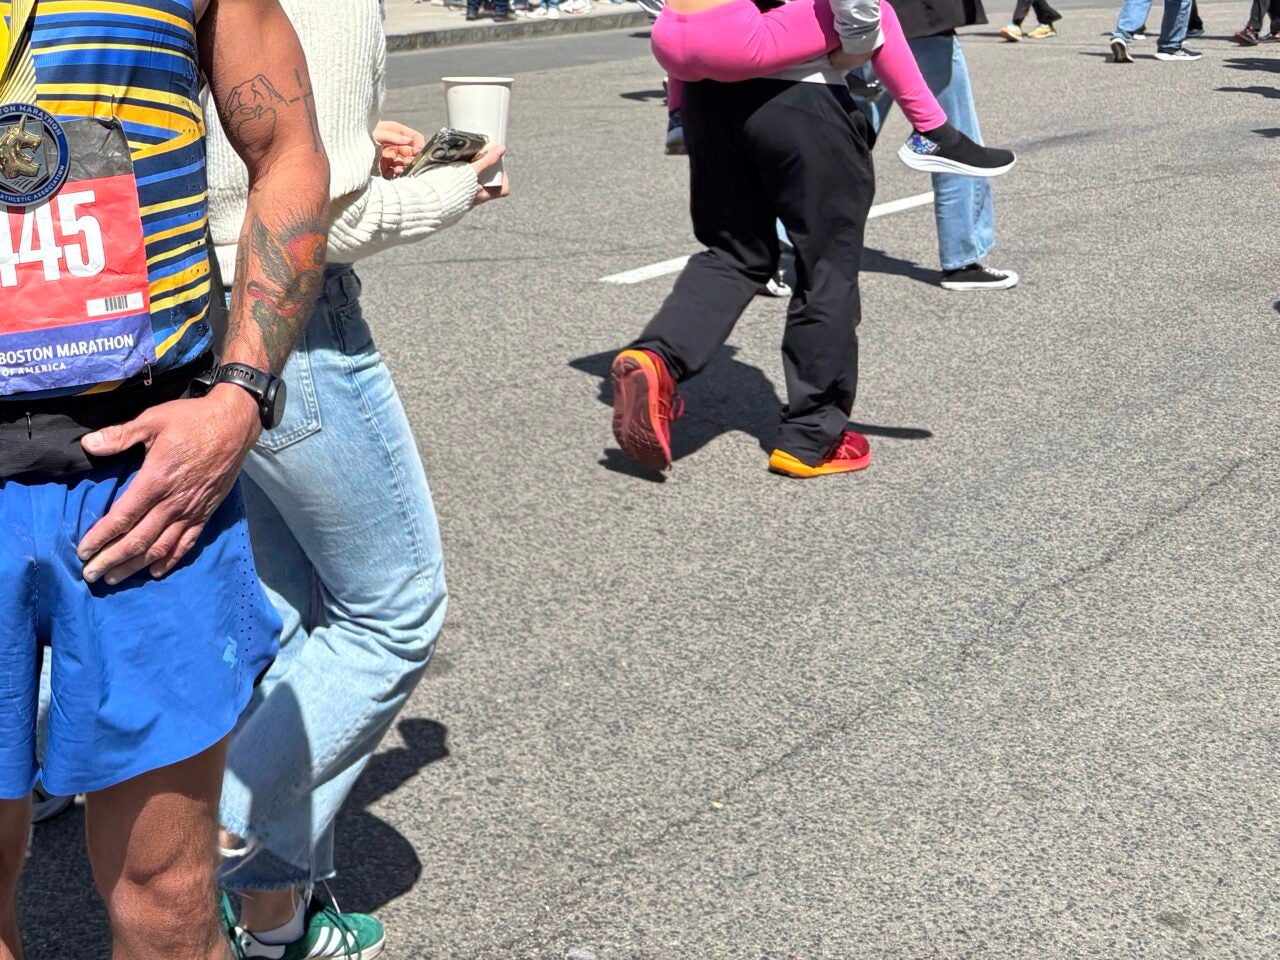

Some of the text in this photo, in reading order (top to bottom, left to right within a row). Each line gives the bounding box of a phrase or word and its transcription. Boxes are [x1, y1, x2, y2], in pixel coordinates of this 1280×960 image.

[18, 105, 63, 136] MARATHON
[0, 193, 32, 203] ATHLETIC
[33, 165, 65, 200] ASSOCIATION
[56, 334, 134, 358] MARATHON
[2, 367, 16, 377] OF
[16, 362, 67, 375] AMERICA
